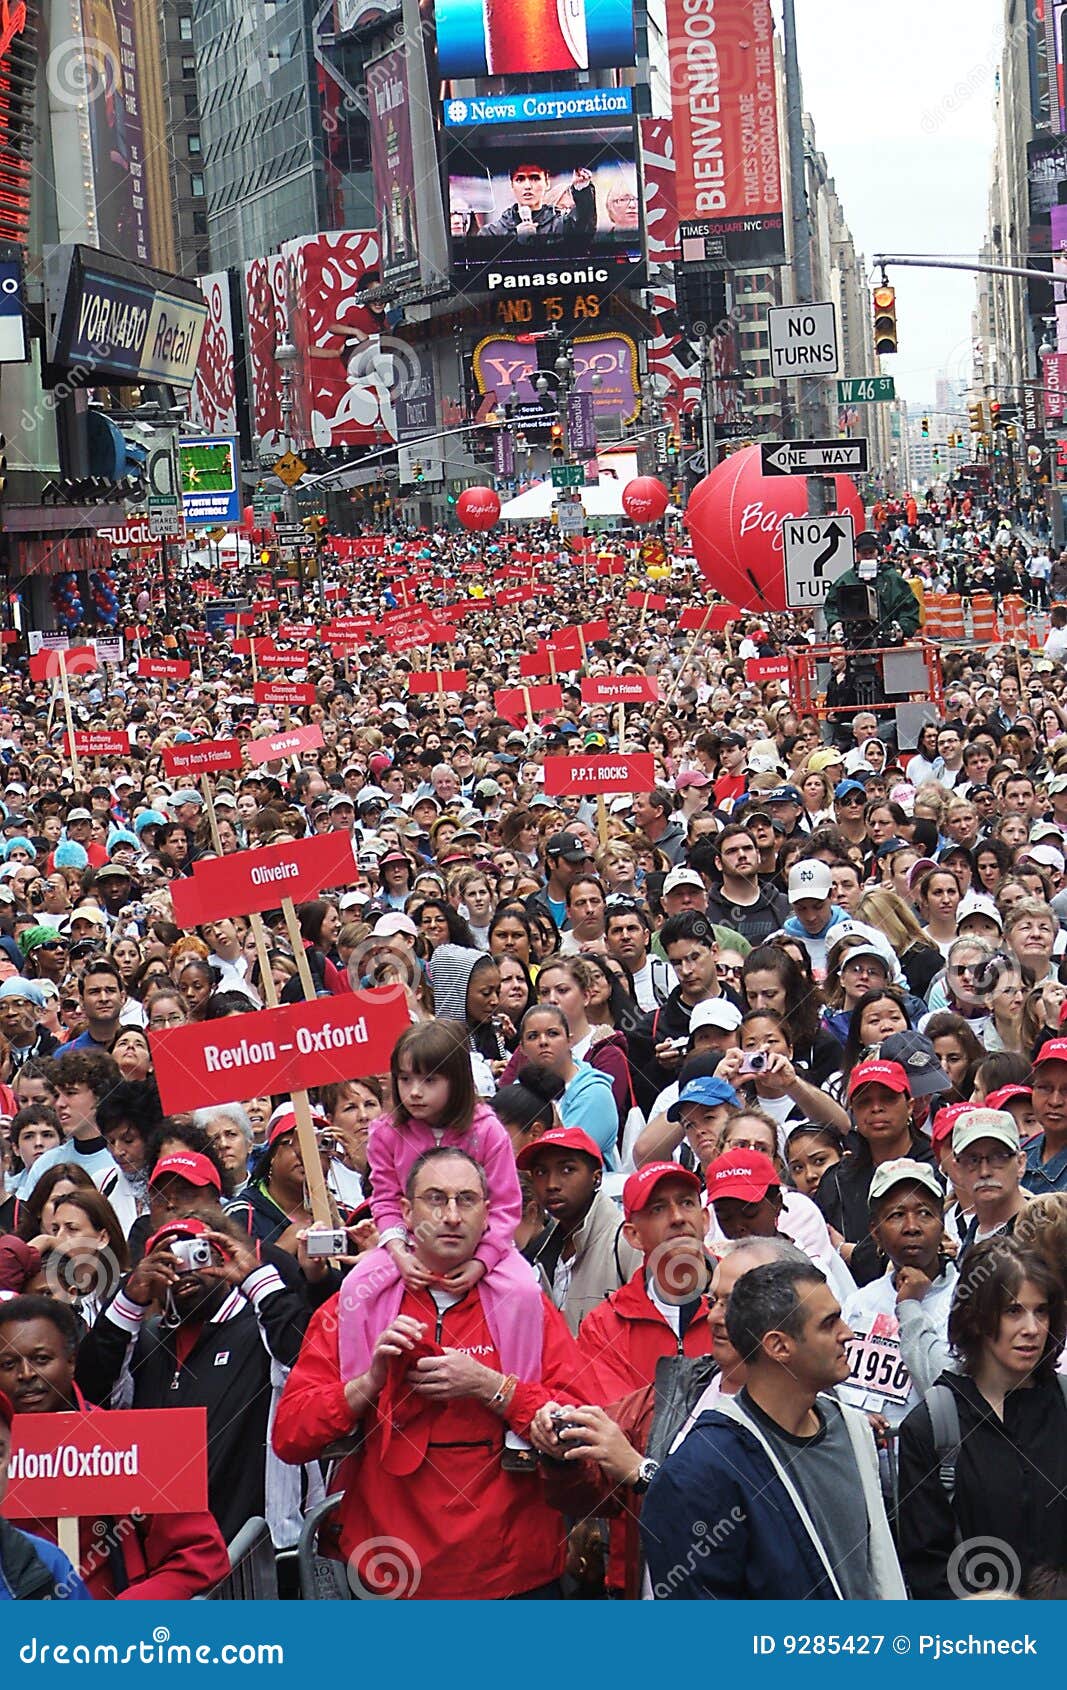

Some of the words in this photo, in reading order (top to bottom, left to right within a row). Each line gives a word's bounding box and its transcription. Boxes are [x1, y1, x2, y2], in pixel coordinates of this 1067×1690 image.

[756, 47, 771, 76] THE
[757, 81, 773, 101] OF
[471, 101, 516, 120] News
[523, 93, 627, 119] Corporation
[684, 0, 727, 211] BIENVENIDOS
[739, 94, 757, 154] SQUARE
[758, 106, 779, 204] CROSSROADS
[744, 157, 760, 206] TIMES
[488, 266, 609, 289] Panasonic
[499, 300, 533, 323] AND
[542, 297, 563, 320] 15
[574, 295, 600, 319] AS
[78, 292, 147, 352] VORNADO
[152, 312, 196, 366] Retail
[788, 317, 817, 337] NO
[774, 344, 834, 365] TURNS
[484, 350, 627, 388] YAOO!
[841, 381, 855, 401] W
[857, 380, 875, 400] 46
[879, 379, 892, 390] ST
[1024, 384, 1035, 410] VENI
[1047, 357, 1060, 416] WELCOME
[1026, 411, 1036, 430] BUN
[777, 451, 807, 465] ONE
[821, 450, 853, 464] WAY
[97, 522, 169, 545] swatc
[790, 525, 821, 544] NO
[796, 581, 832, 598] TUR
[264, 694, 289, 702] Children's
[597, 684, 619, 695] Mary's
[619, 684, 643, 694] Friends
[74, 744, 89, 752] oung
[90, 743, 103, 751] Adult
[104, 743, 123, 752] Society
[90, 735, 111, 744] Anthony
[173, 755, 190, 767] Mary
[190, 753, 208, 764] Ann's
[208, 750, 232, 762] Friends
[571, 767, 597, 781] P.P.T.
[598, 766, 629, 780] ROCKS
[250, 862, 300, 886] Oliveira
[203, 1039, 276, 1073] Revlon
[296, 1016, 369, 1055] Oxford
[858, 1066, 892, 1077] REVLON
[161, 1157, 197, 1167] REVLON
[716, 1168, 752, 1180] REVLON
[8, 1443, 139, 1480] vlon/Oxford
